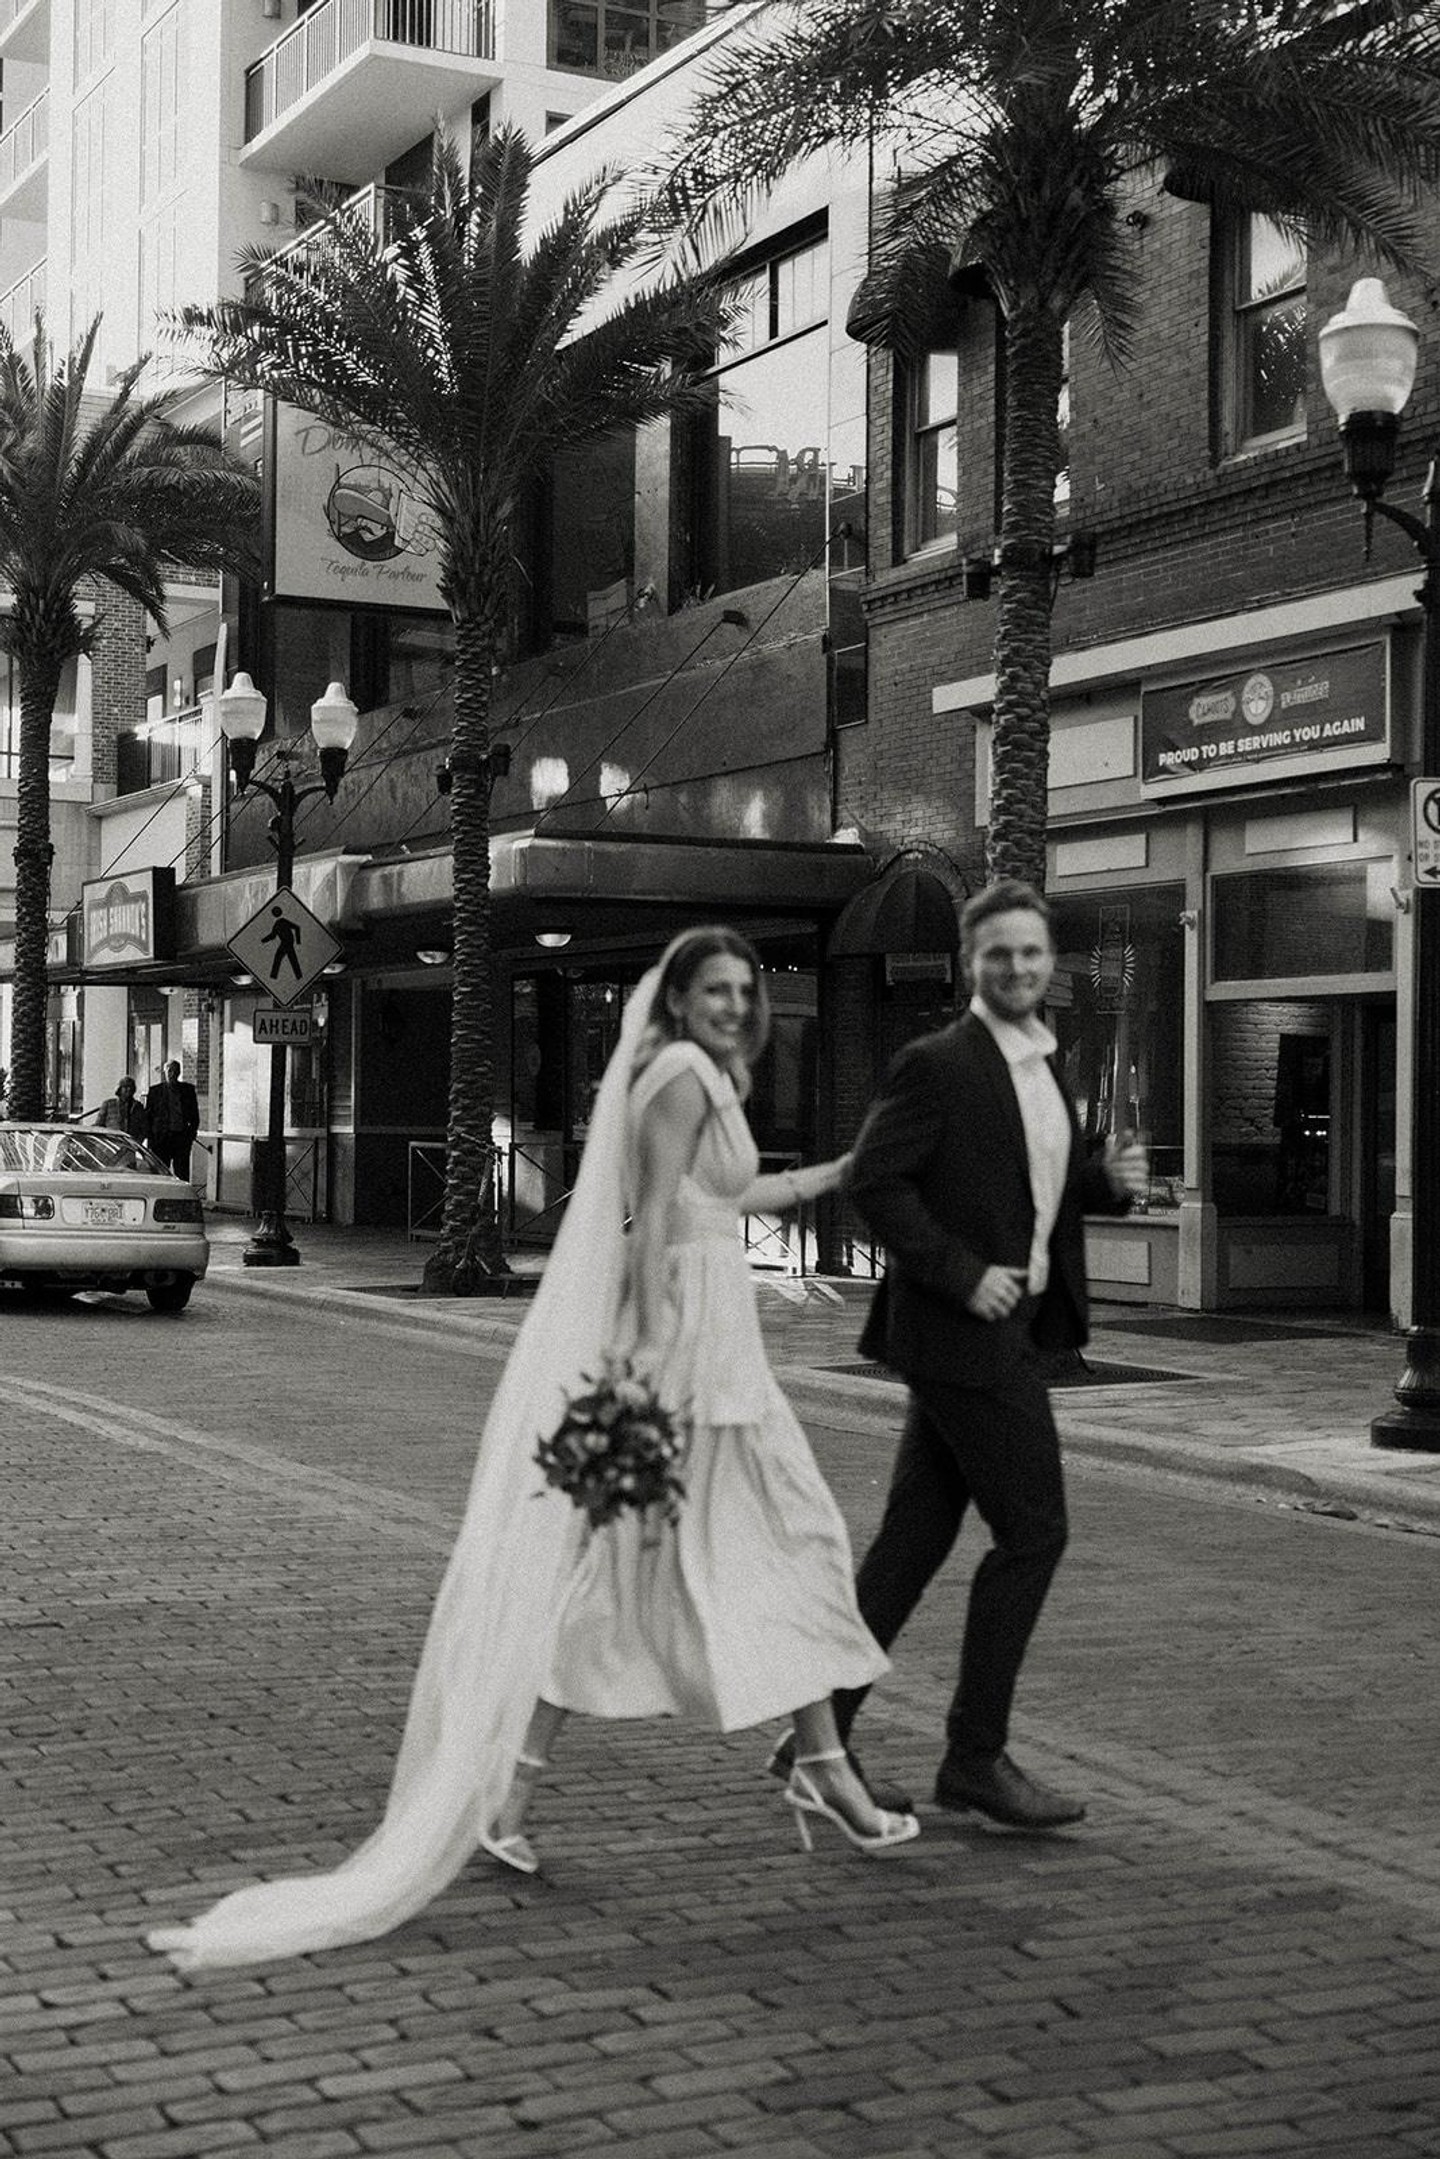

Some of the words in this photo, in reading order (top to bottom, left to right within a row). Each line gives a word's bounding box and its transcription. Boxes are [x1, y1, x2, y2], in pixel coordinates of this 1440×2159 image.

[321, 557, 369, 583] Tequila
[1158, 746, 1200, 767] PROUD
[1200, 743, 1217, 759] TO
[1218, 739, 1236, 757] BE
[1236, 731, 1292, 752] SERVING
[1292, 724, 1321, 743] YOU
[1323, 716, 1366, 738] AGAIN
[258, 1018, 308, 1036] AHEAD
